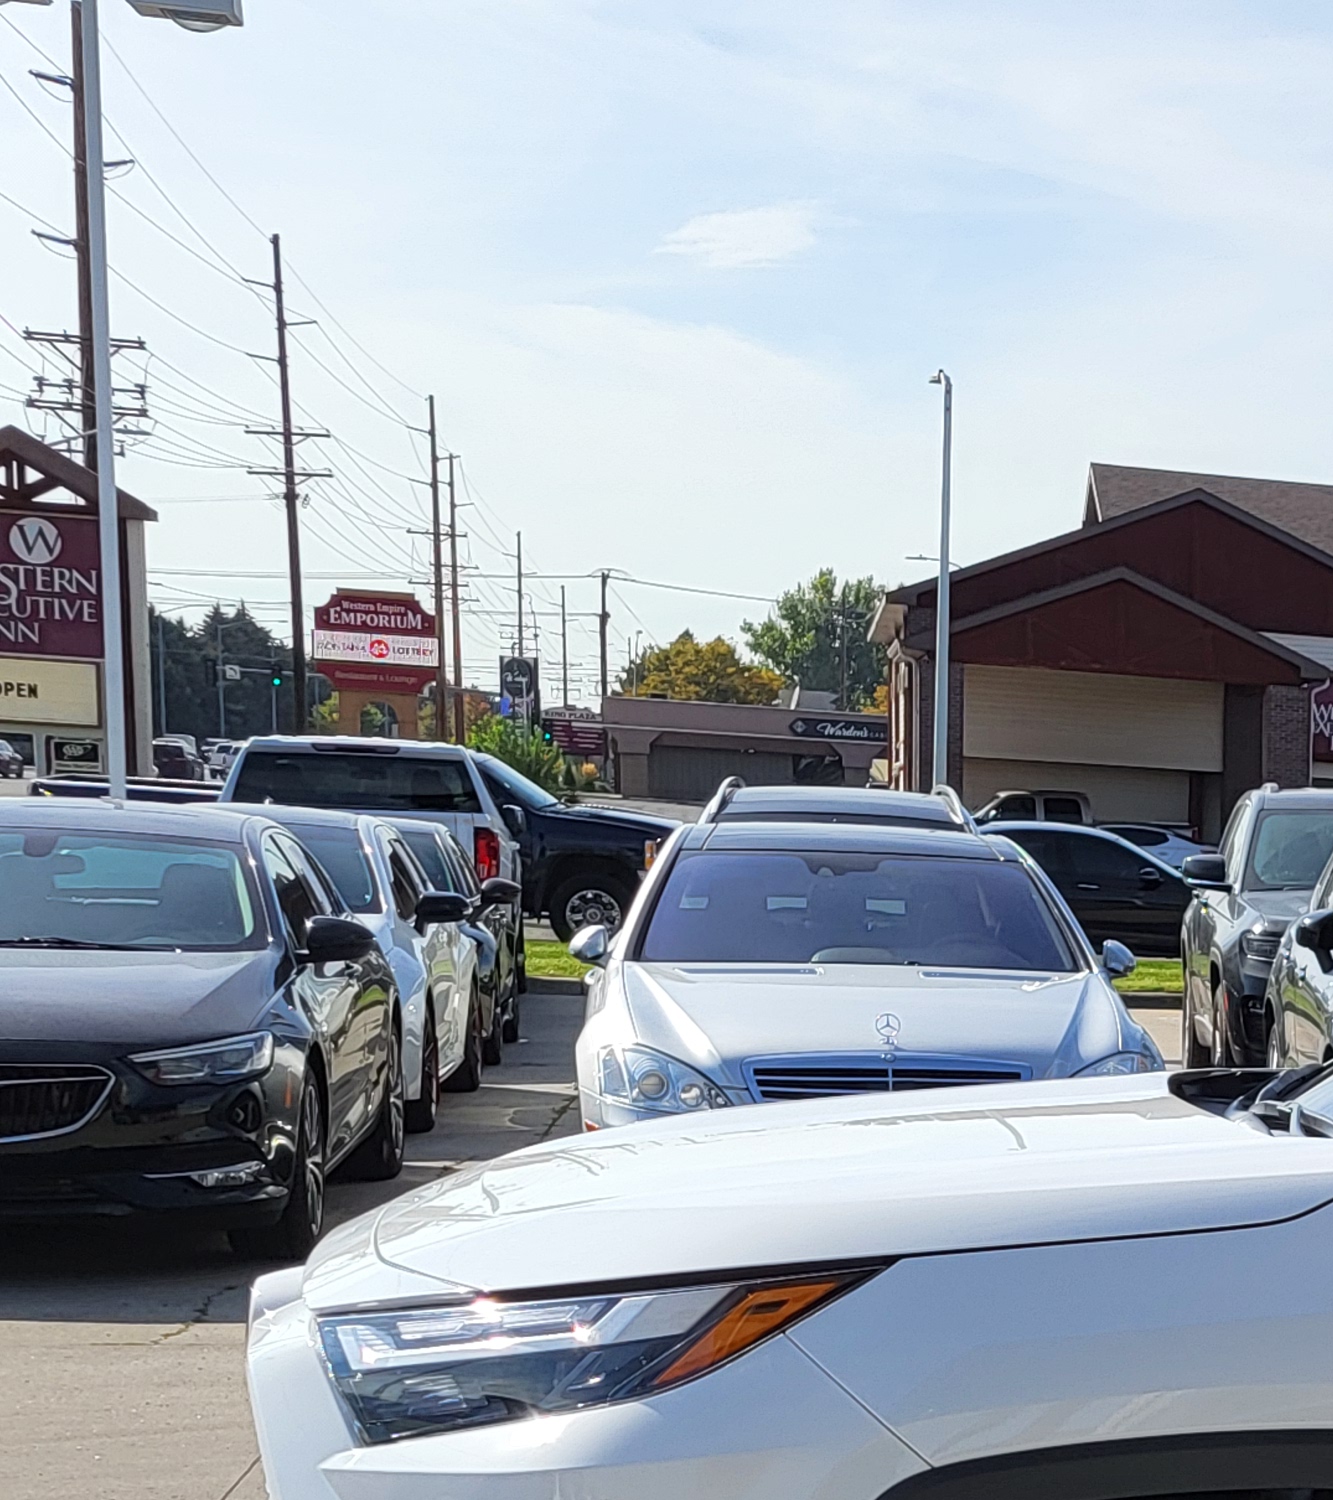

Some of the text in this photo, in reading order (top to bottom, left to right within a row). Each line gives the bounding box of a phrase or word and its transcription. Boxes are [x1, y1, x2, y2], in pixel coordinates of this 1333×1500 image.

[15, 523, 60, 558] W
[341, 600, 406, 615] Western Empire
[329, 606, 422, 630] EMPORIUM
[568, 712, 597, 720] PLAZA
